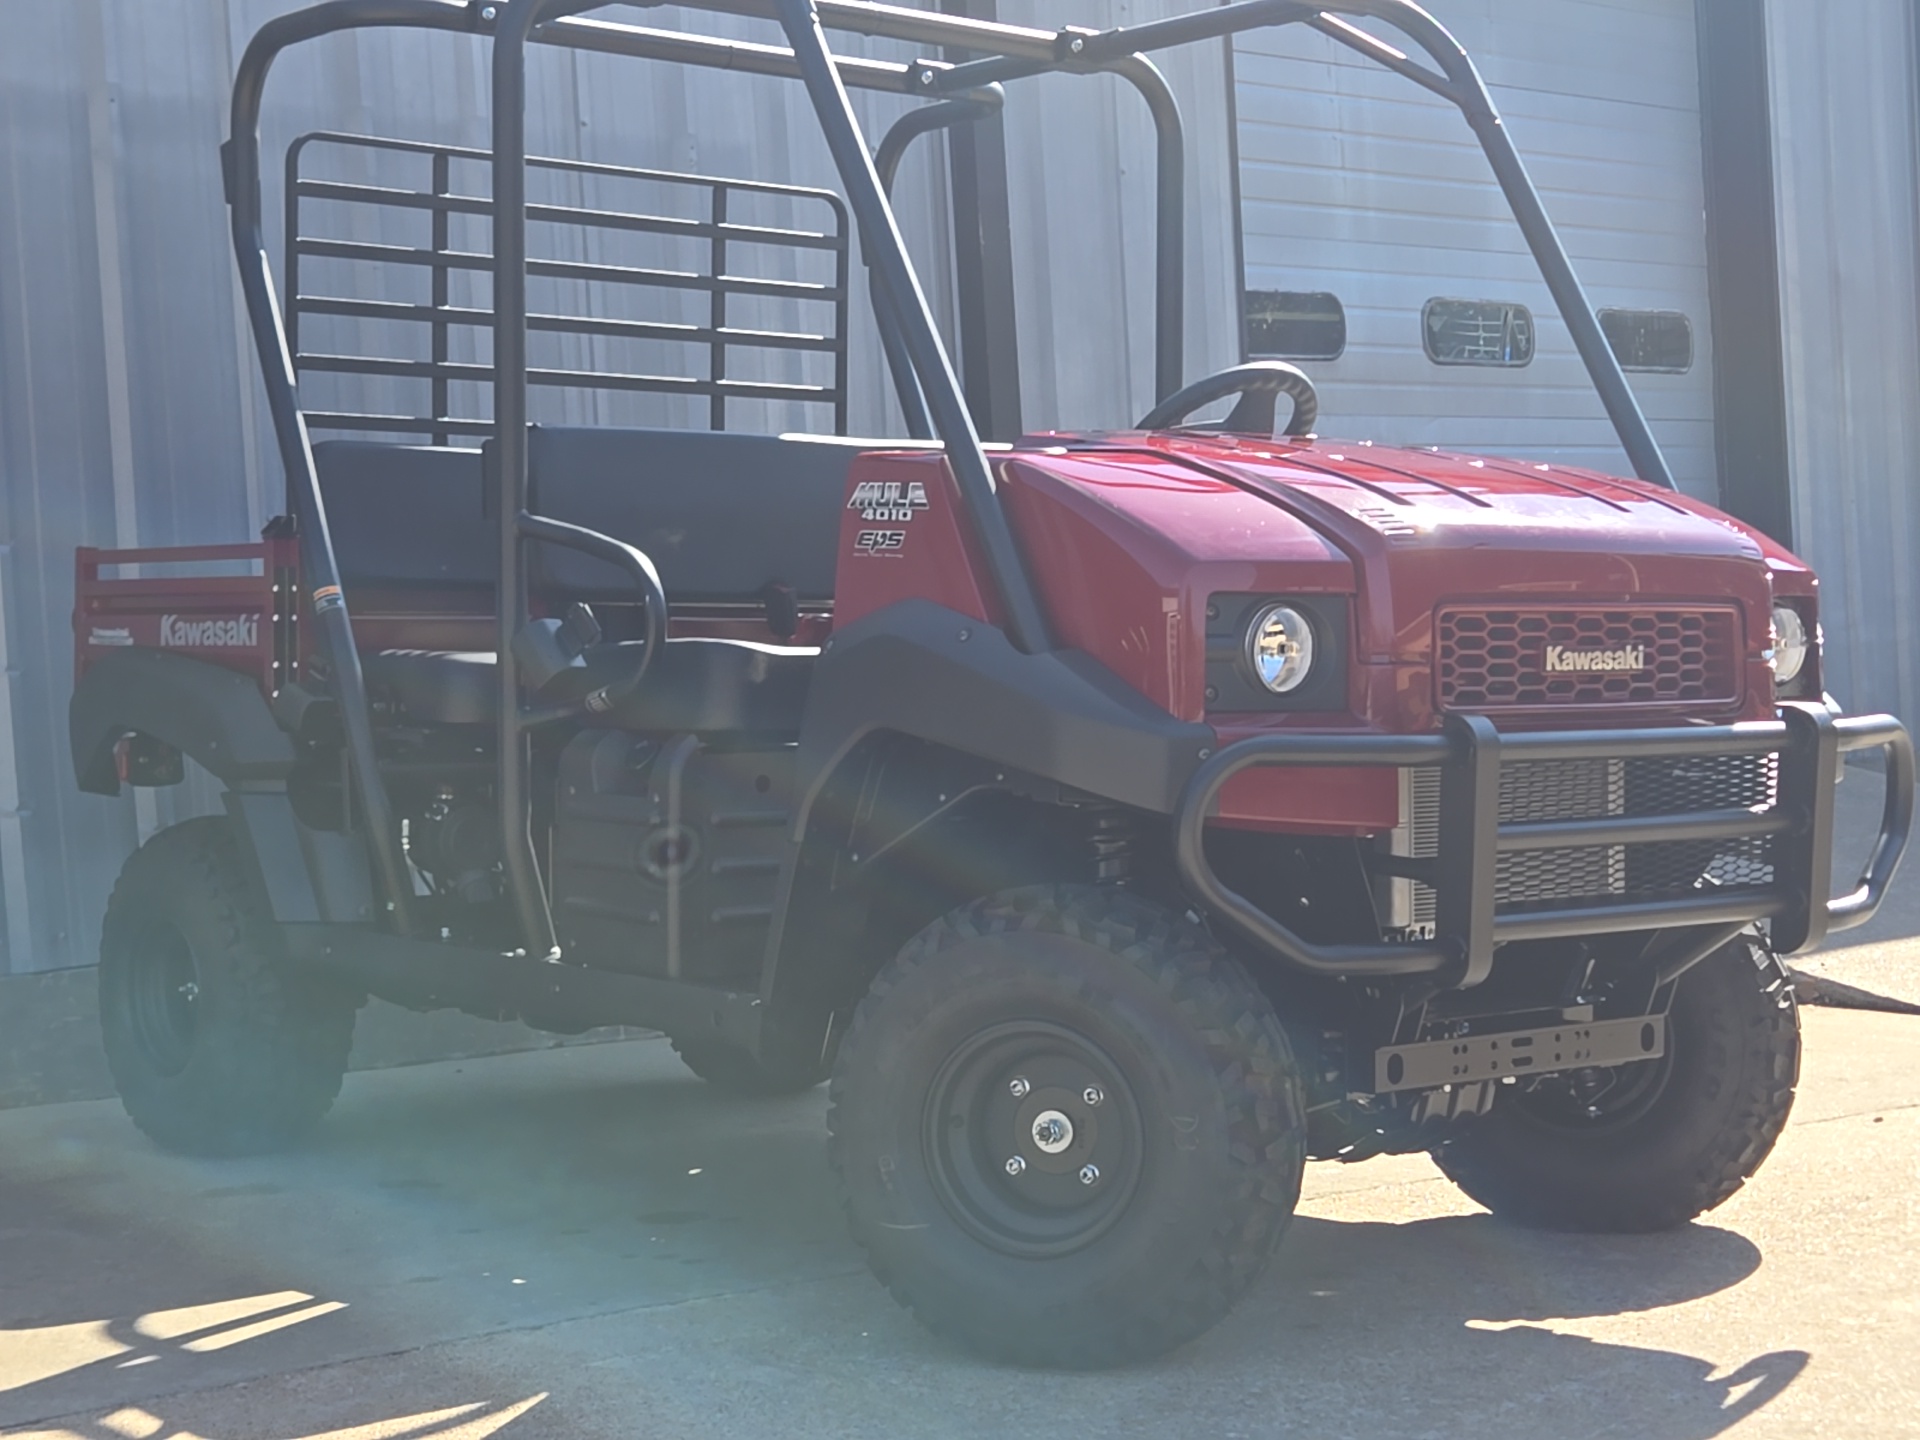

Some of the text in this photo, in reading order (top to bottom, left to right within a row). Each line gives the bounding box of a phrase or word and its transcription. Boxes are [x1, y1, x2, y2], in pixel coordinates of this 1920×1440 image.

[847, 482, 929, 509] MULE
[861, 509, 912, 521] 4010
[160, 613, 260, 646] Kawasaki
[1546, 645, 1644, 671] Kawasaki
